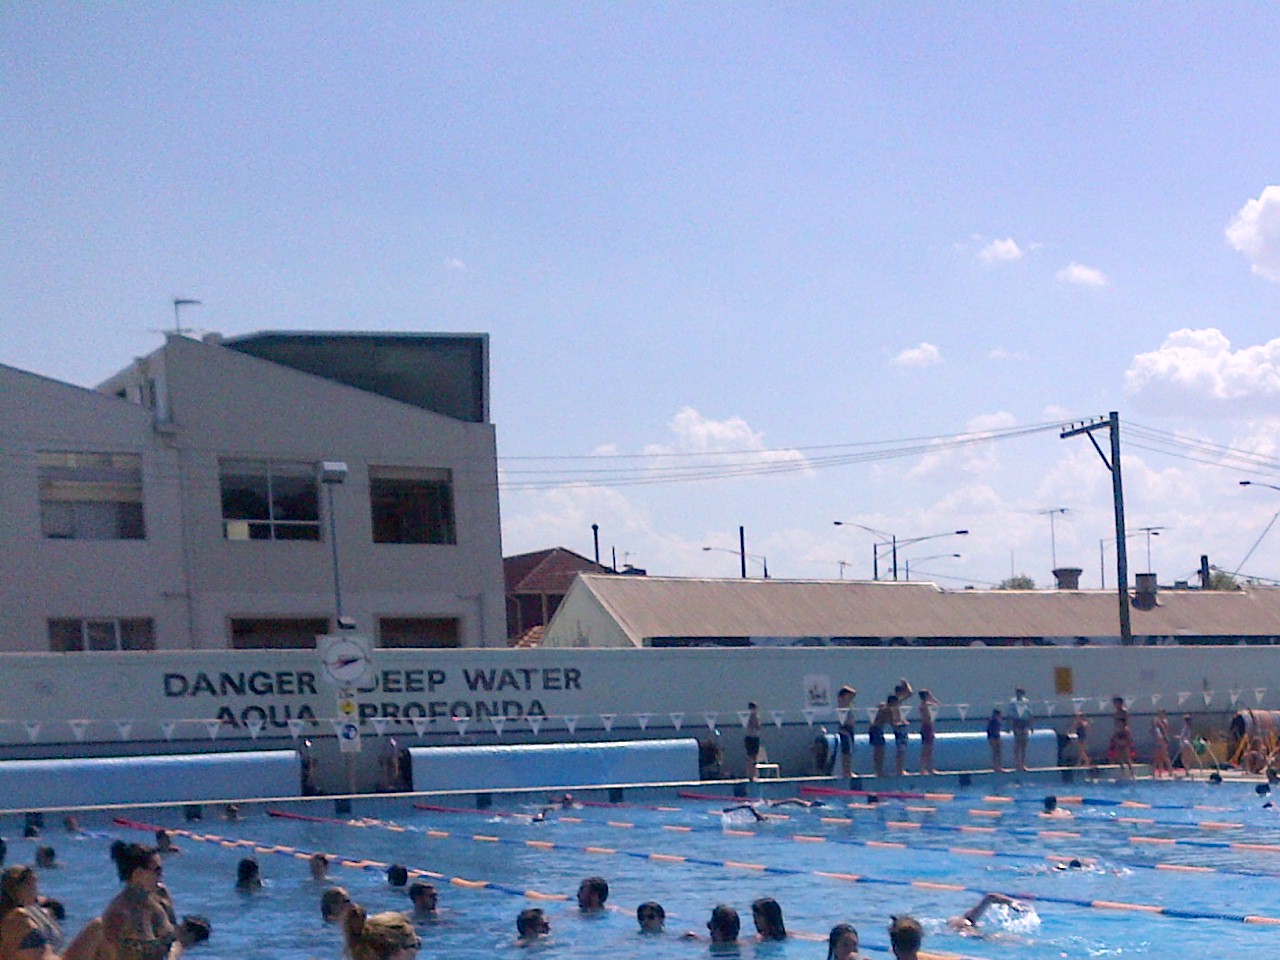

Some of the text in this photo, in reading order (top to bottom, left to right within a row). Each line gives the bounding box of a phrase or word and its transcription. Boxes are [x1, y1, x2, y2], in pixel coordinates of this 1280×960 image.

[164, 671, 318, 697] DANGER
[462, 668, 582, 692] WATER
[216, 699, 548, 730] AQUA PROFONDA
